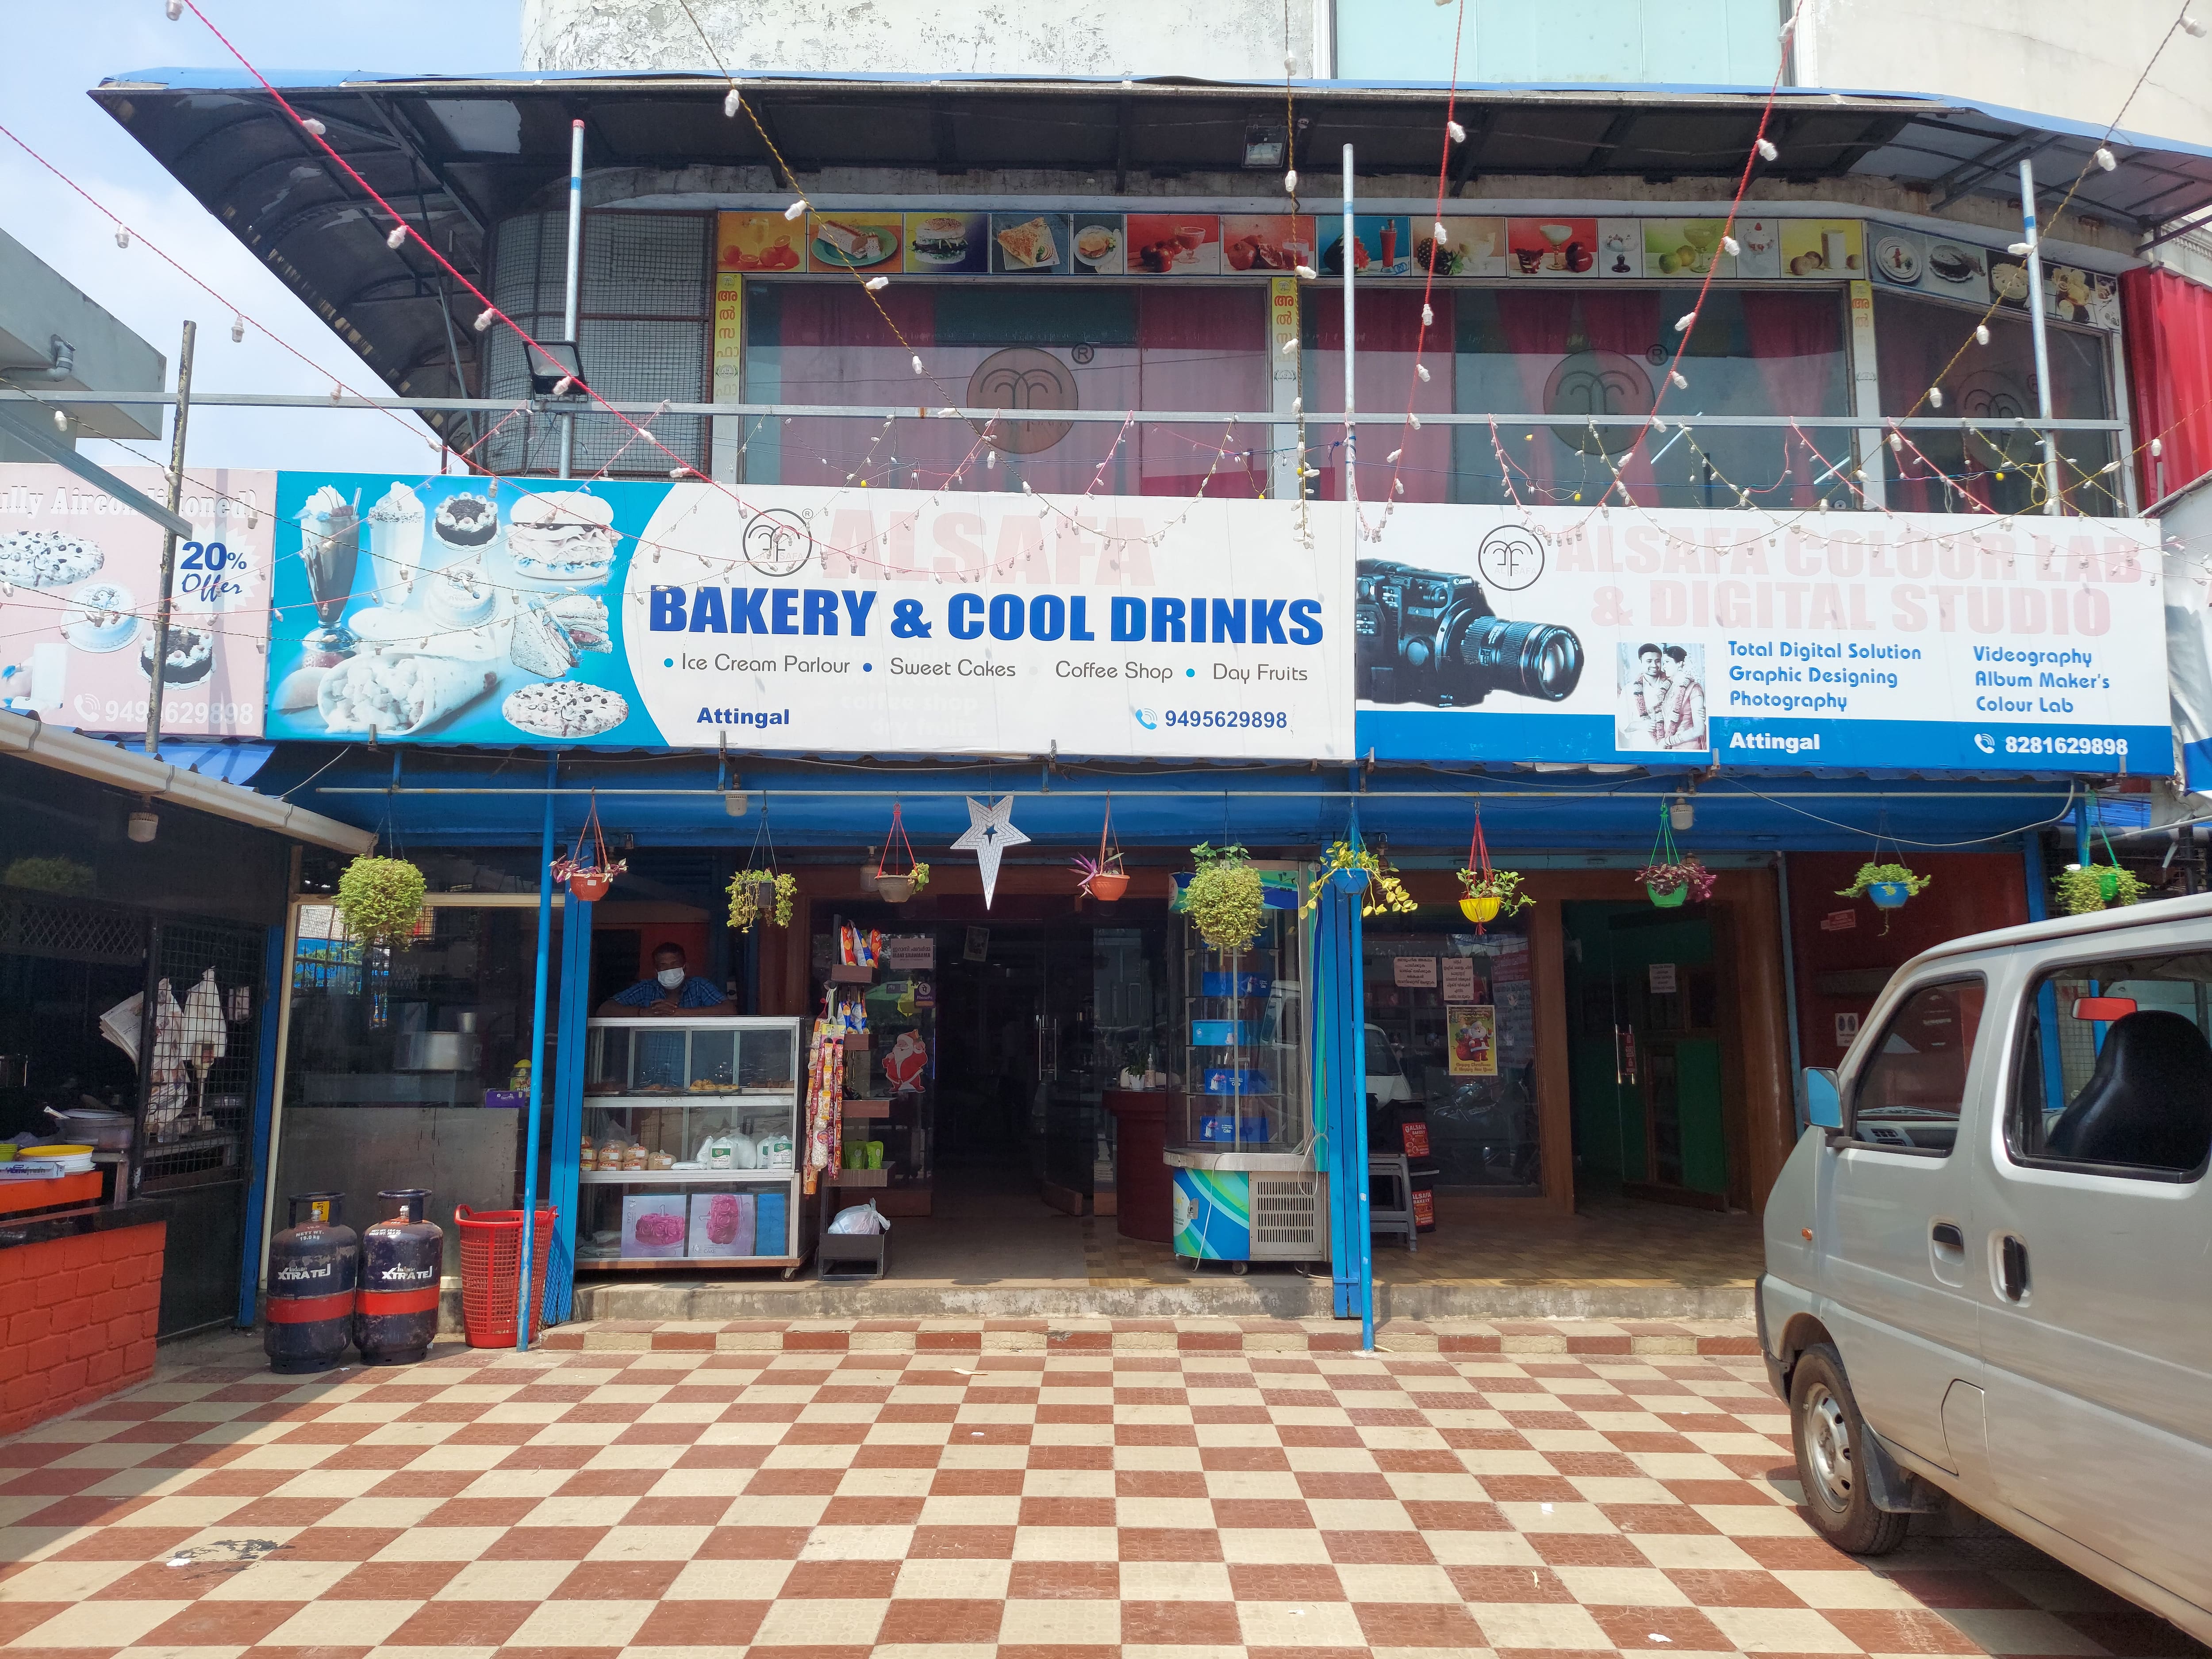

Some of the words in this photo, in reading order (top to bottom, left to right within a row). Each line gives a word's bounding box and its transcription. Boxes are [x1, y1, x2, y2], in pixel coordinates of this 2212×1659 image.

[180, 541, 247, 571] 20%
[822, 509, 1155, 586] ALSAFA
[1555, 524, 1770, 575] ALSAFA
[1784, 528, 2017, 580] COLOUR
[2035, 534, 2141, 584] LAB
[181, 573, 243, 602] Offer
[649, 584, 877, 636] BAKERY
[891, 598, 932, 638] &
[948, 593, 1094, 641] COOL
[1111, 596, 1323, 645] DRINKS
[1650, 580, 1875, 630] DIGITAL
[1892, 583, 2111, 636] STUDIO
[1728, 641, 1773, 657] Total
[1780, 641, 1841, 661] Digital
[1848, 643, 1921, 660] Solution
[1973, 645, 2092, 667] Videography
[682, 653, 707, 670] Ice
[714, 653, 776, 672] Cream
[784, 655, 850, 673] Parlour
[890, 657, 951, 676] Sweet
[957, 659, 1016, 677] Cakes
[1056, 660, 1118, 679] Coffee
[1125, 661, 1173, 683] Shop
[1213, 663, 1250, 685] Day
[1257, 664, 1308, 681] Fruits
[1729, 665, 1801, 686] Graphic
[1809, 668, 1898, 688] Designing
[1975, 671, 2032, 687] Album
[2039, 672, 2110, 690] Maker's
[1730, 690, 1847, 710] Photography
[1976, 696, 2032, 713] Colour
[2040, 697, 2074, 713] Lab
[105, 700, 253, 725] 949629898
[697, 707, 790, 729] Attingal
[1165, 710, 1287, 729] 9495629898
[1729, 732, 1820, 754] Attingal
[2005, 736, 2128, 755] 8281629898
